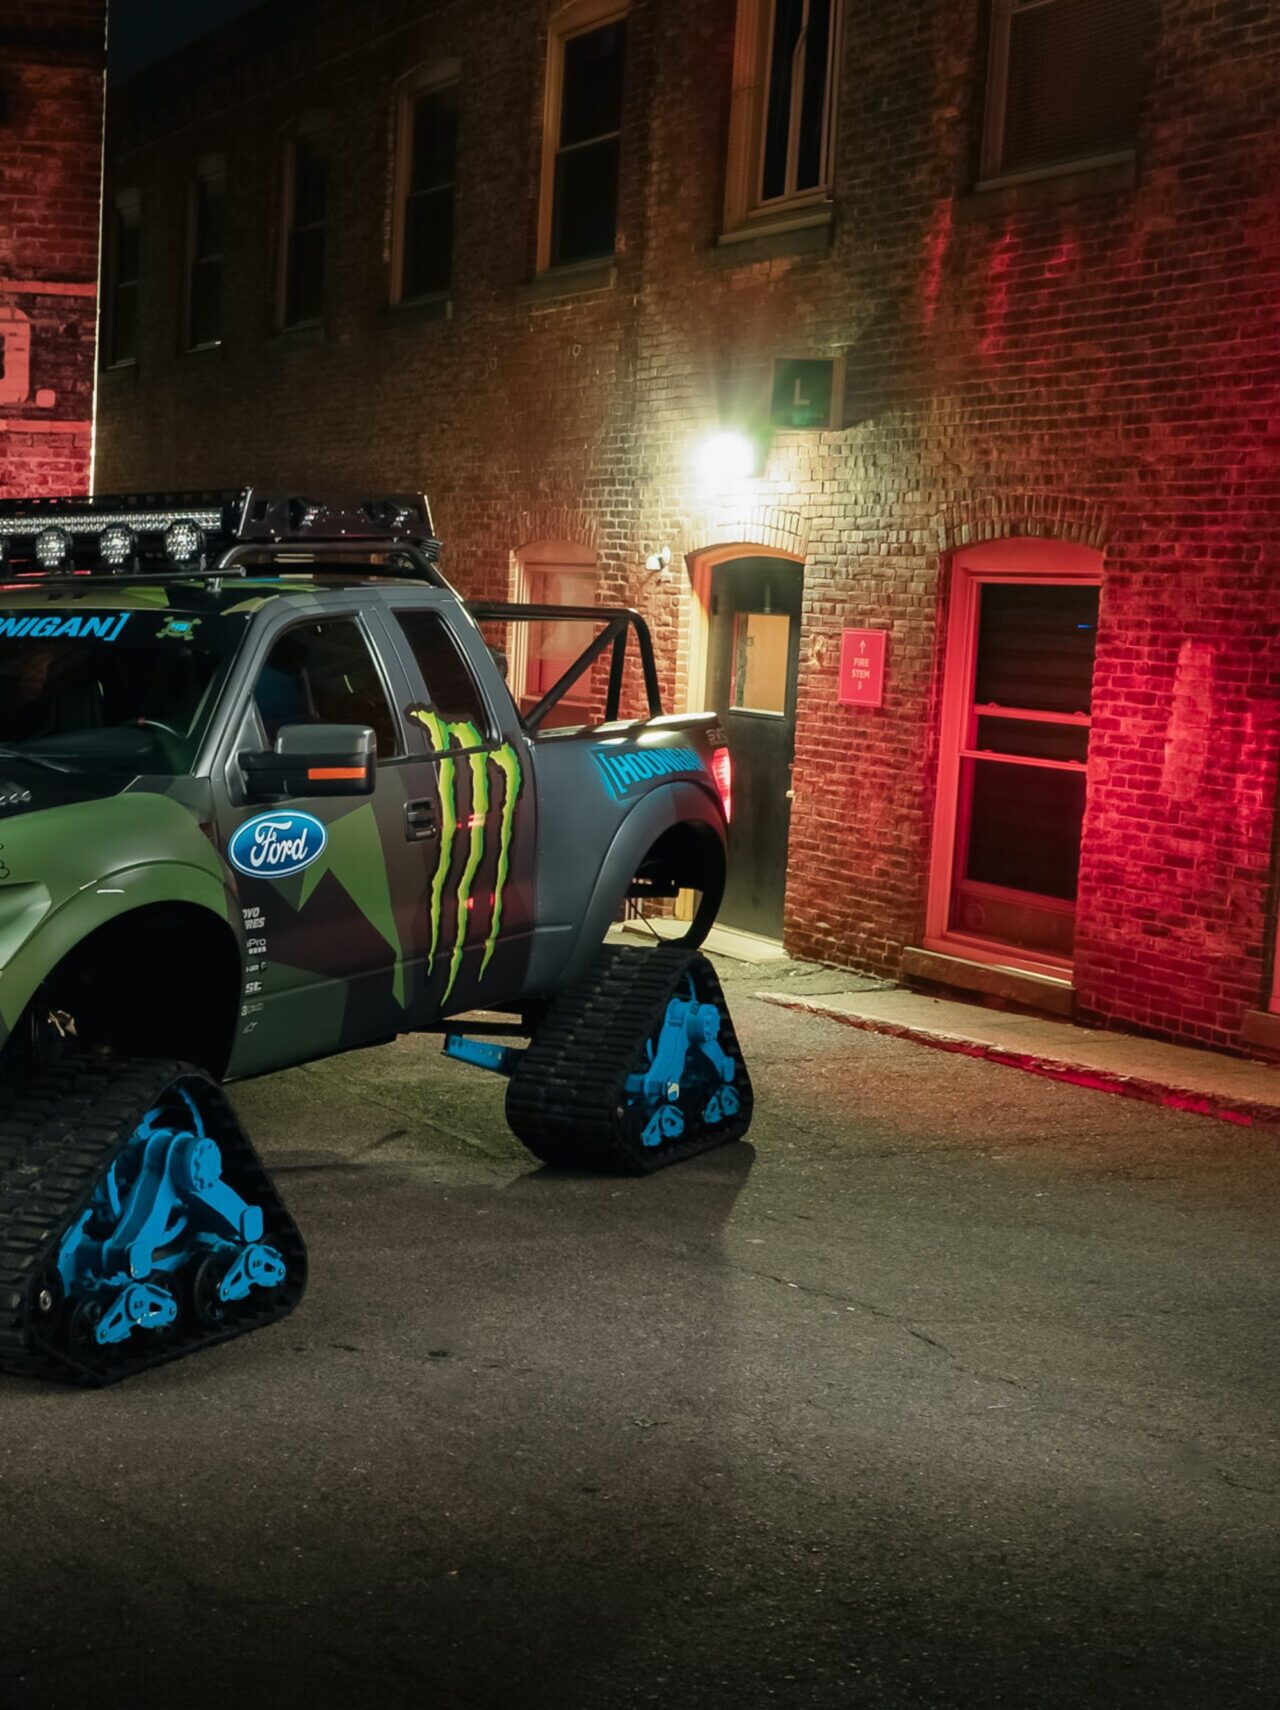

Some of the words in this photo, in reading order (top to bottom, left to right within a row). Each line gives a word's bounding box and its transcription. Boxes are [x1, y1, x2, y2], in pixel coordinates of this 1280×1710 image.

[853, 657, 870, 668] FIRE
[851, 668, 871, 679] STEM
[249, 820, 309, 867] Ford
